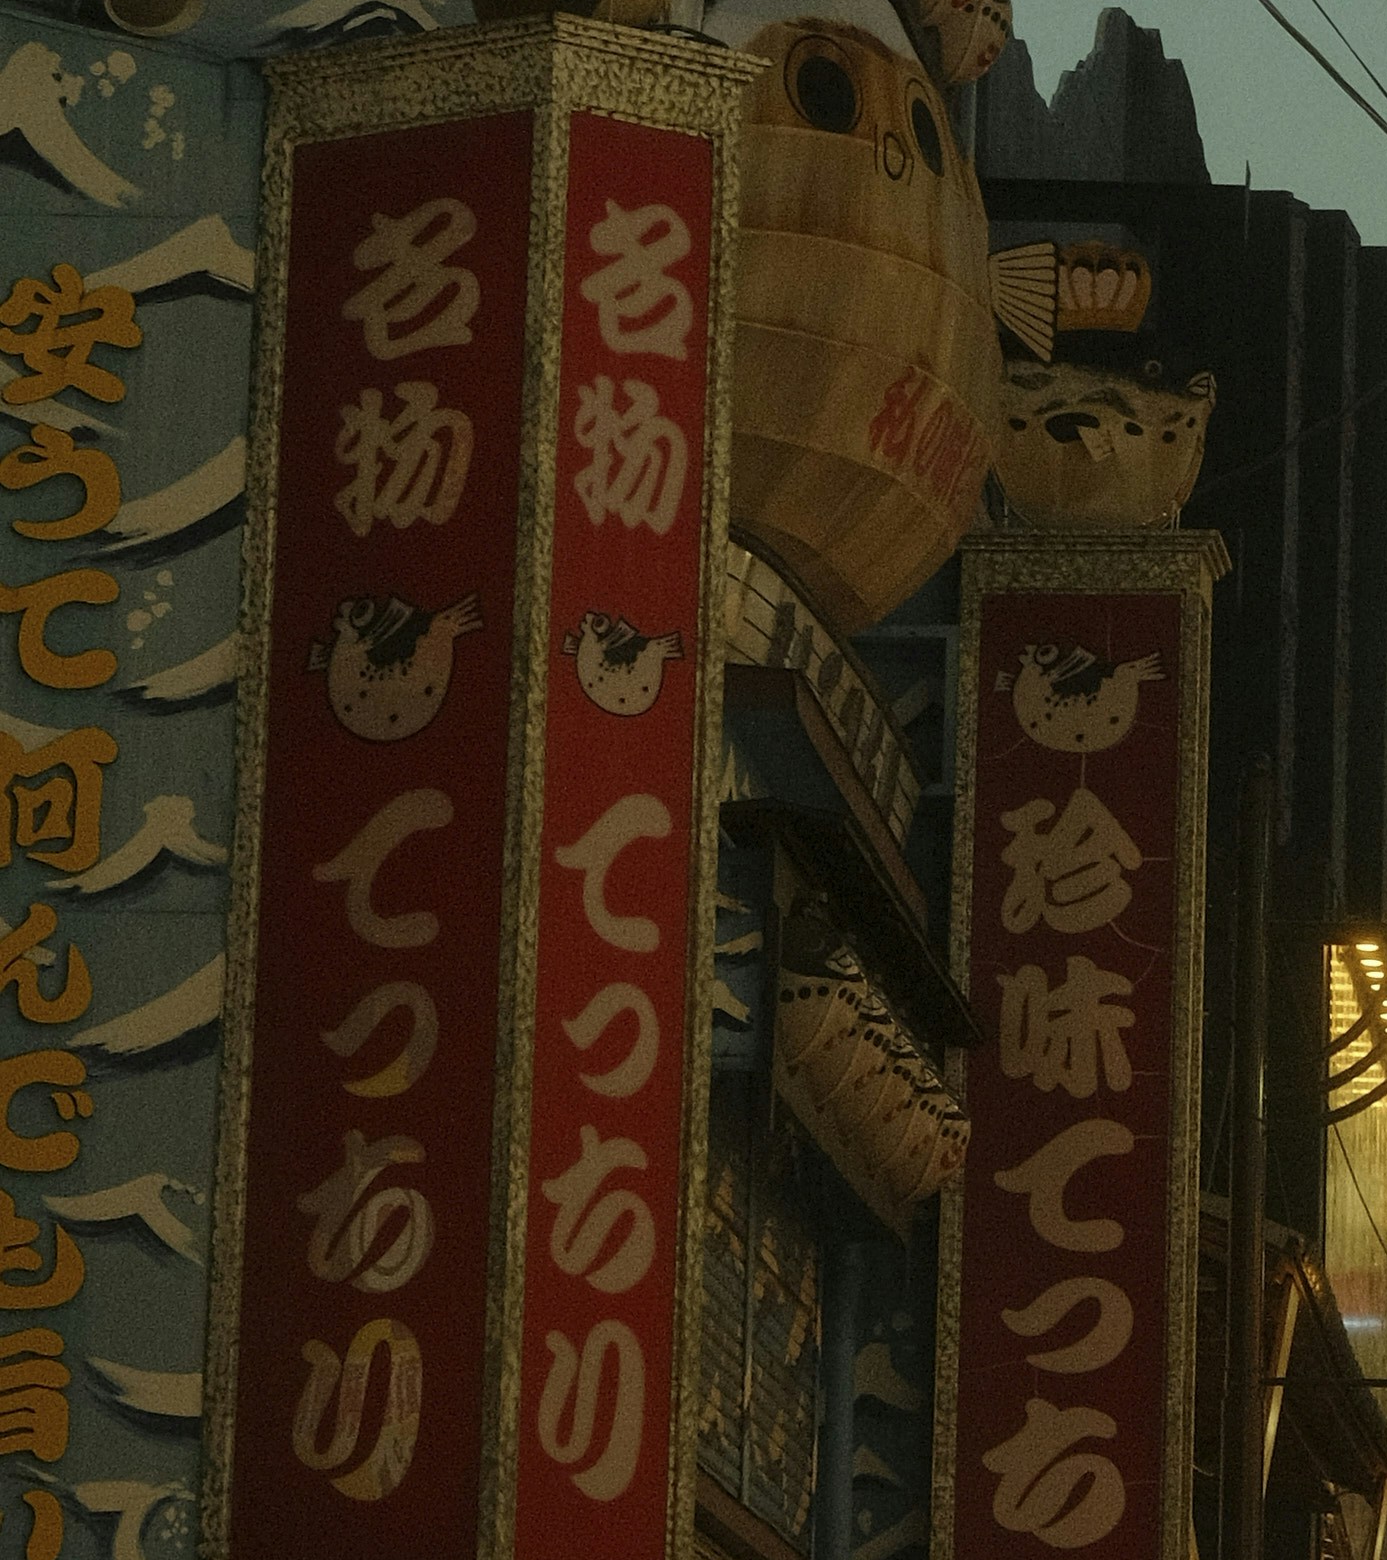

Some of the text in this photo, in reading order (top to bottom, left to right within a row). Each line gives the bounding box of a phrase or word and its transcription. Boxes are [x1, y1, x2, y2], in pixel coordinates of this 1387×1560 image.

[338, 198, 486, 536] 名物
[574, 198, 696, 536] 名物
[291, 786, 455, 1502] てっちり
[538, 786, 675, 1501] てっちり
